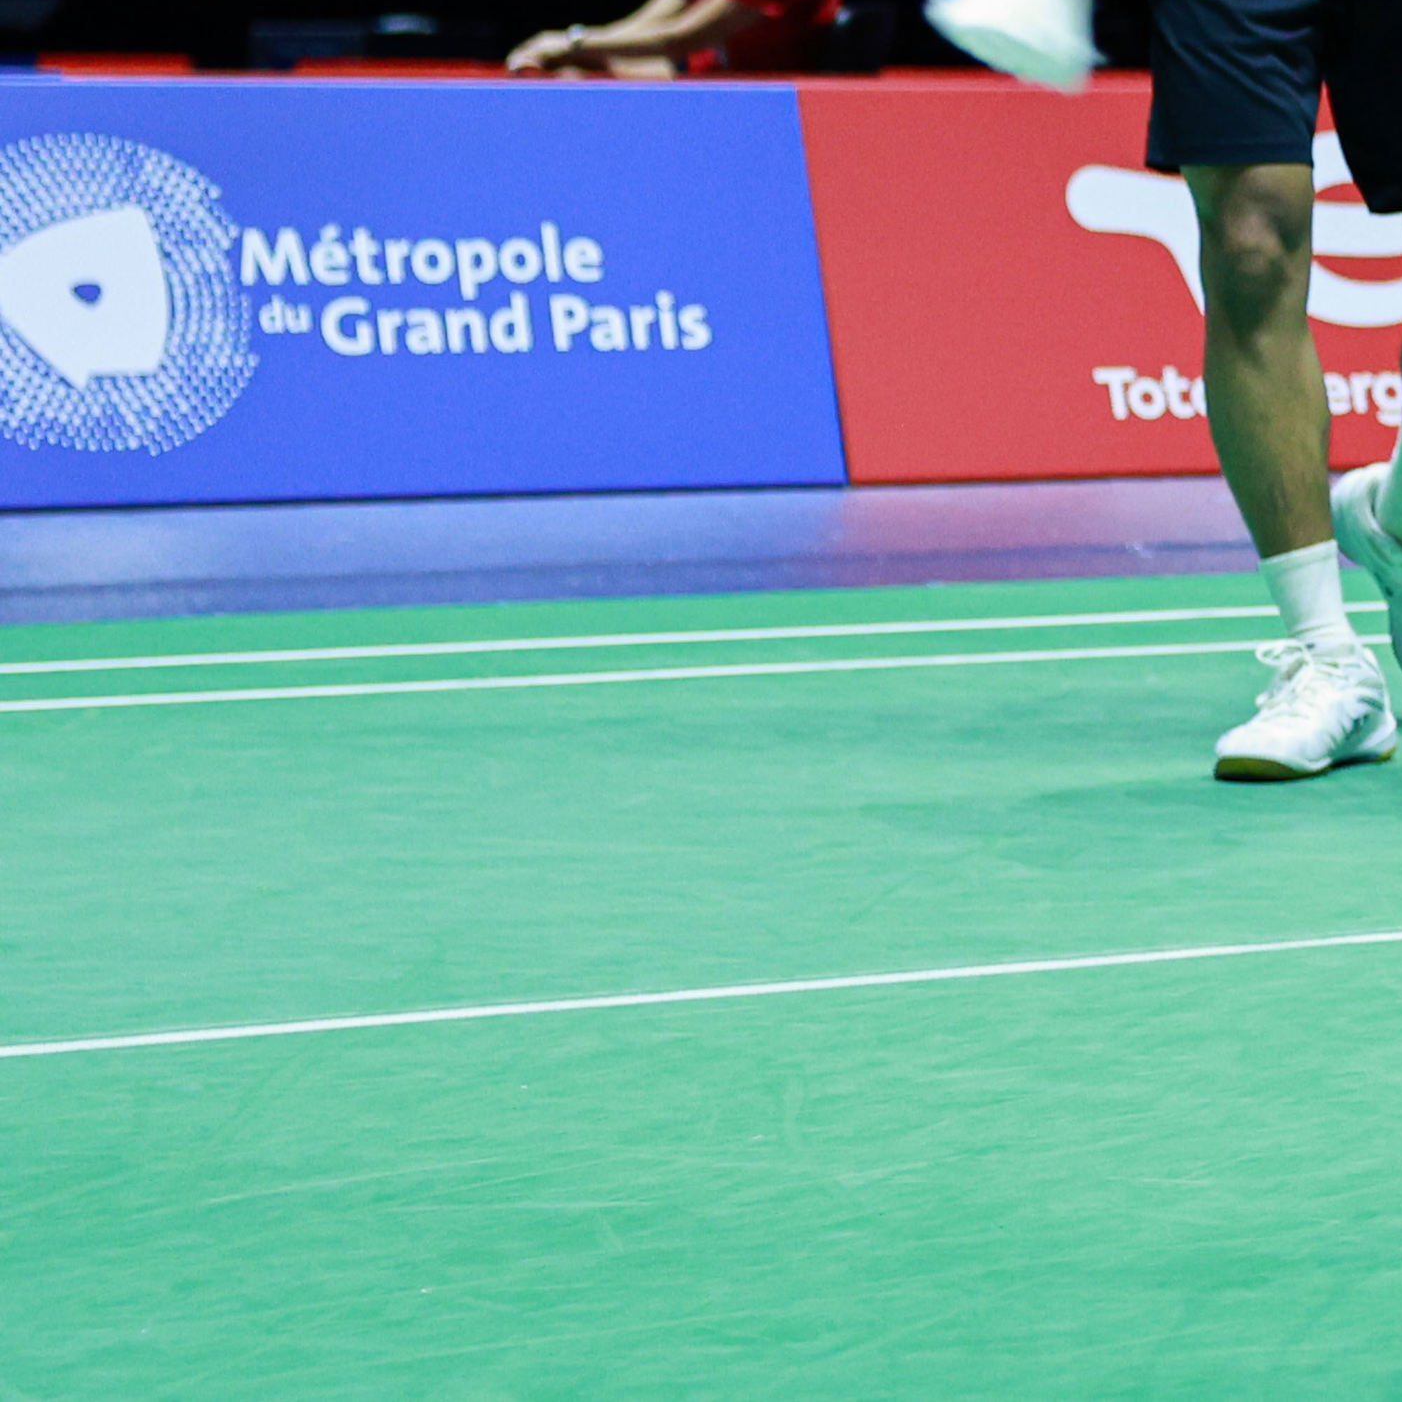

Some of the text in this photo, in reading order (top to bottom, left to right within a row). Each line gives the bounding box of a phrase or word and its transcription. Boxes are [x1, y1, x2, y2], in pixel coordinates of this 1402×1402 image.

[239, 221, 604, 300] Métropole
[258, 290, 713, 357] du Grand Paris
